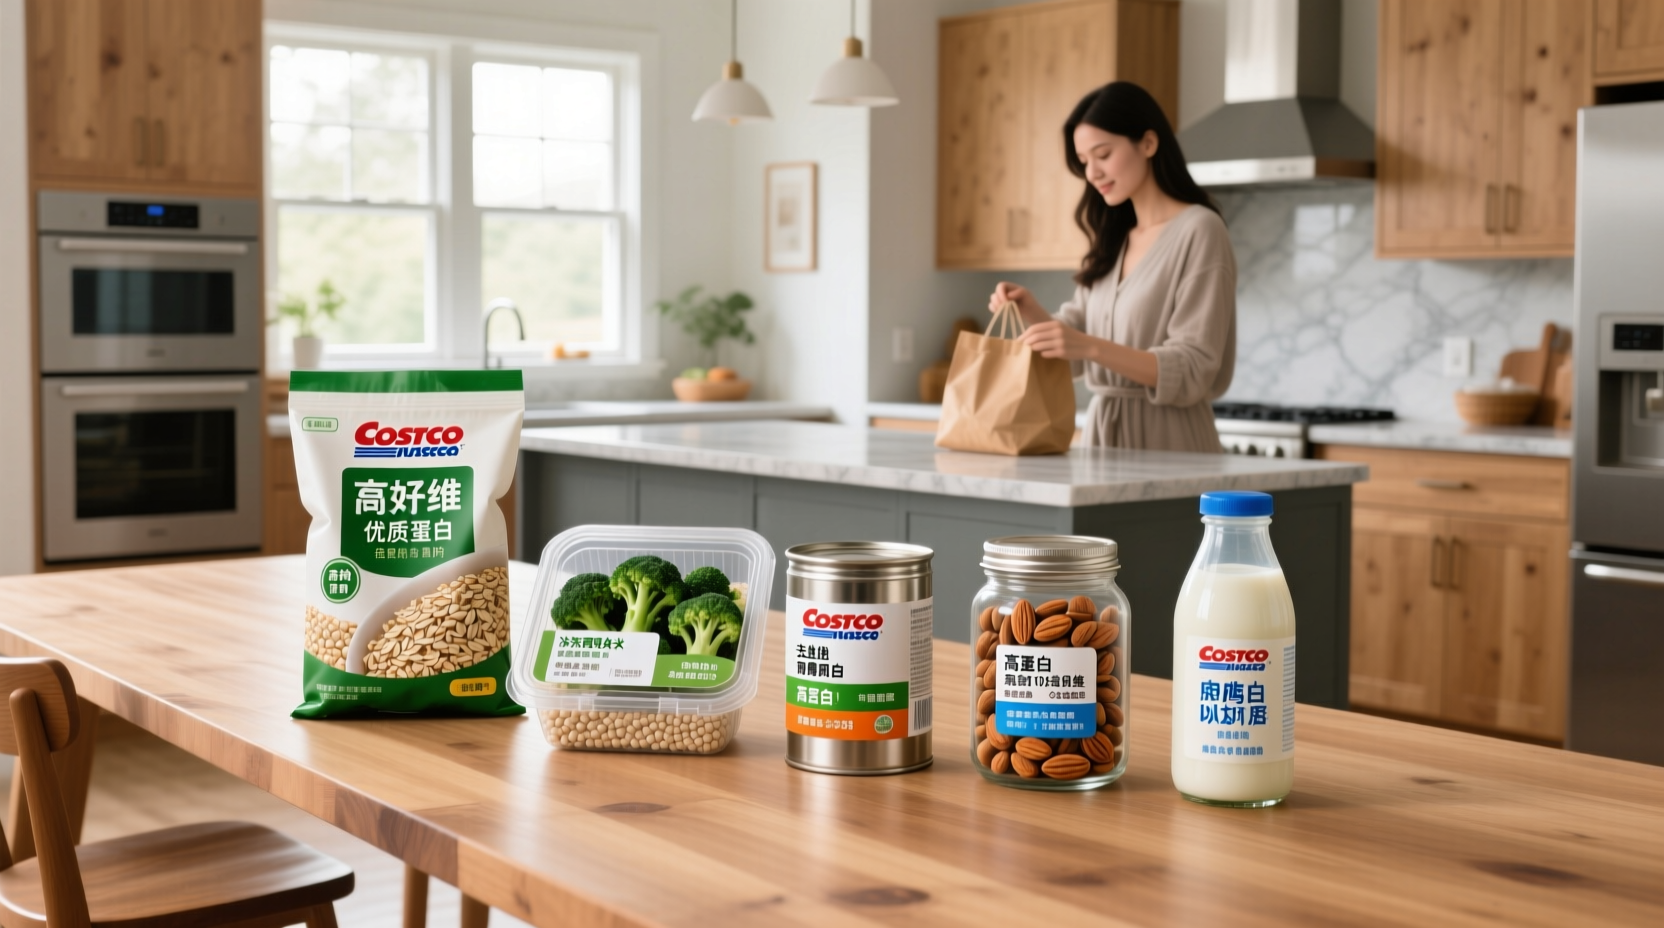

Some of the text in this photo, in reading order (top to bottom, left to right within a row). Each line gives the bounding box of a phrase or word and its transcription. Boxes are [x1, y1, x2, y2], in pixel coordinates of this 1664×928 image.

[354, 421, 464, 446] COSTCO
[354, 478, 462, 515] 高好维
[364, 518, 452, 543] 优质蛋白
[803, 608, 884, 630] COSTCO
[1199, 645, 1269, 663] COSTCO
